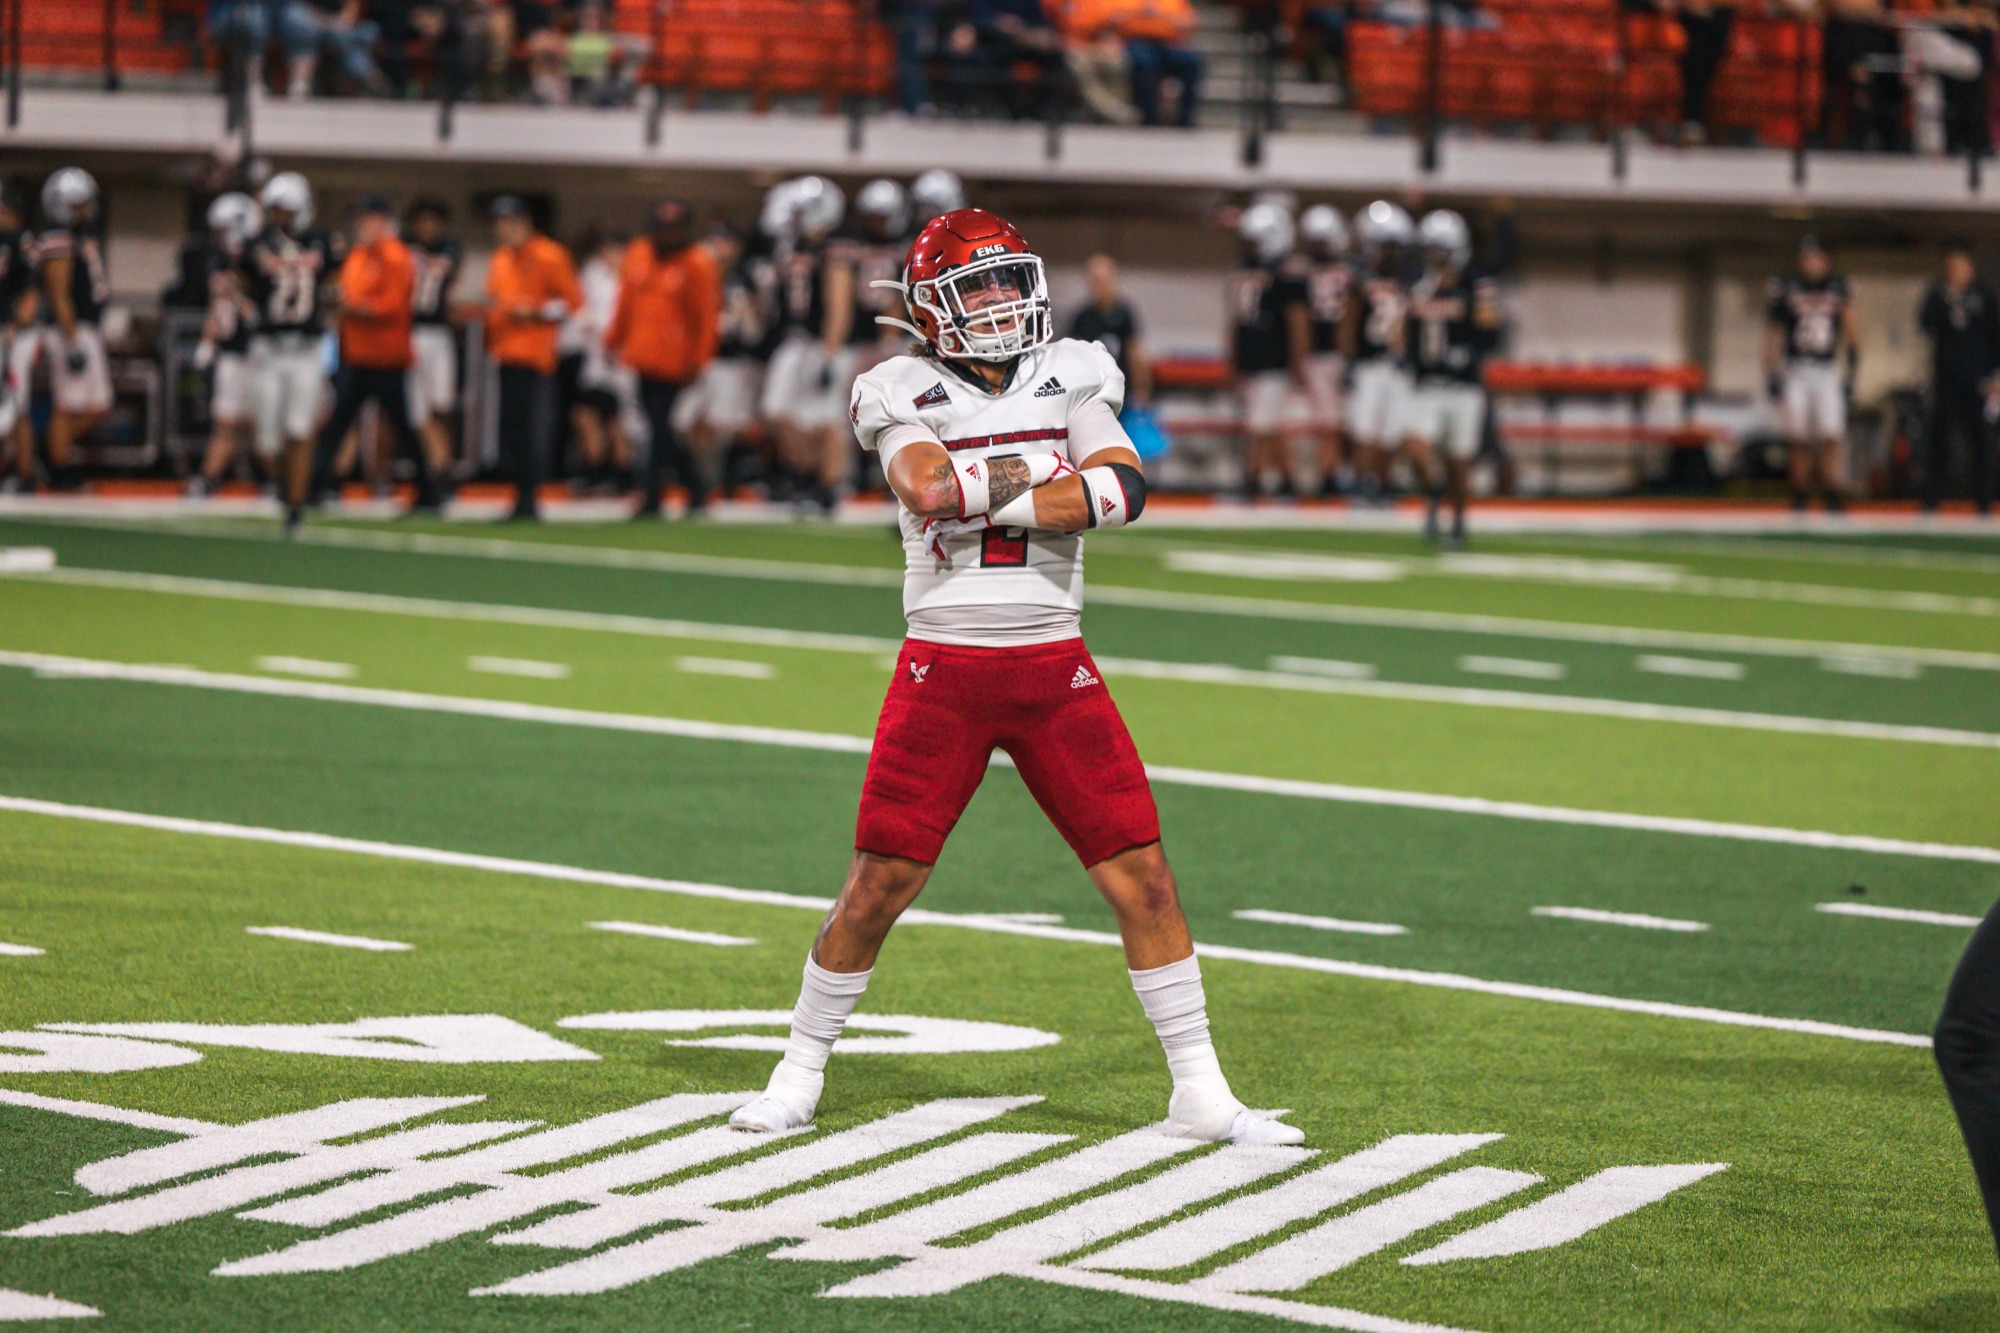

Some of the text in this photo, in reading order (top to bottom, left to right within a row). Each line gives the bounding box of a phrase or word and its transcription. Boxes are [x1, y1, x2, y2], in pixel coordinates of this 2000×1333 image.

[976, 244, 1005, 257] EKG
[925, 385, 945, 400] SKY
[1034, 387, 1066, 398] adidas
[1070, 677, 1099, 689] adidas
